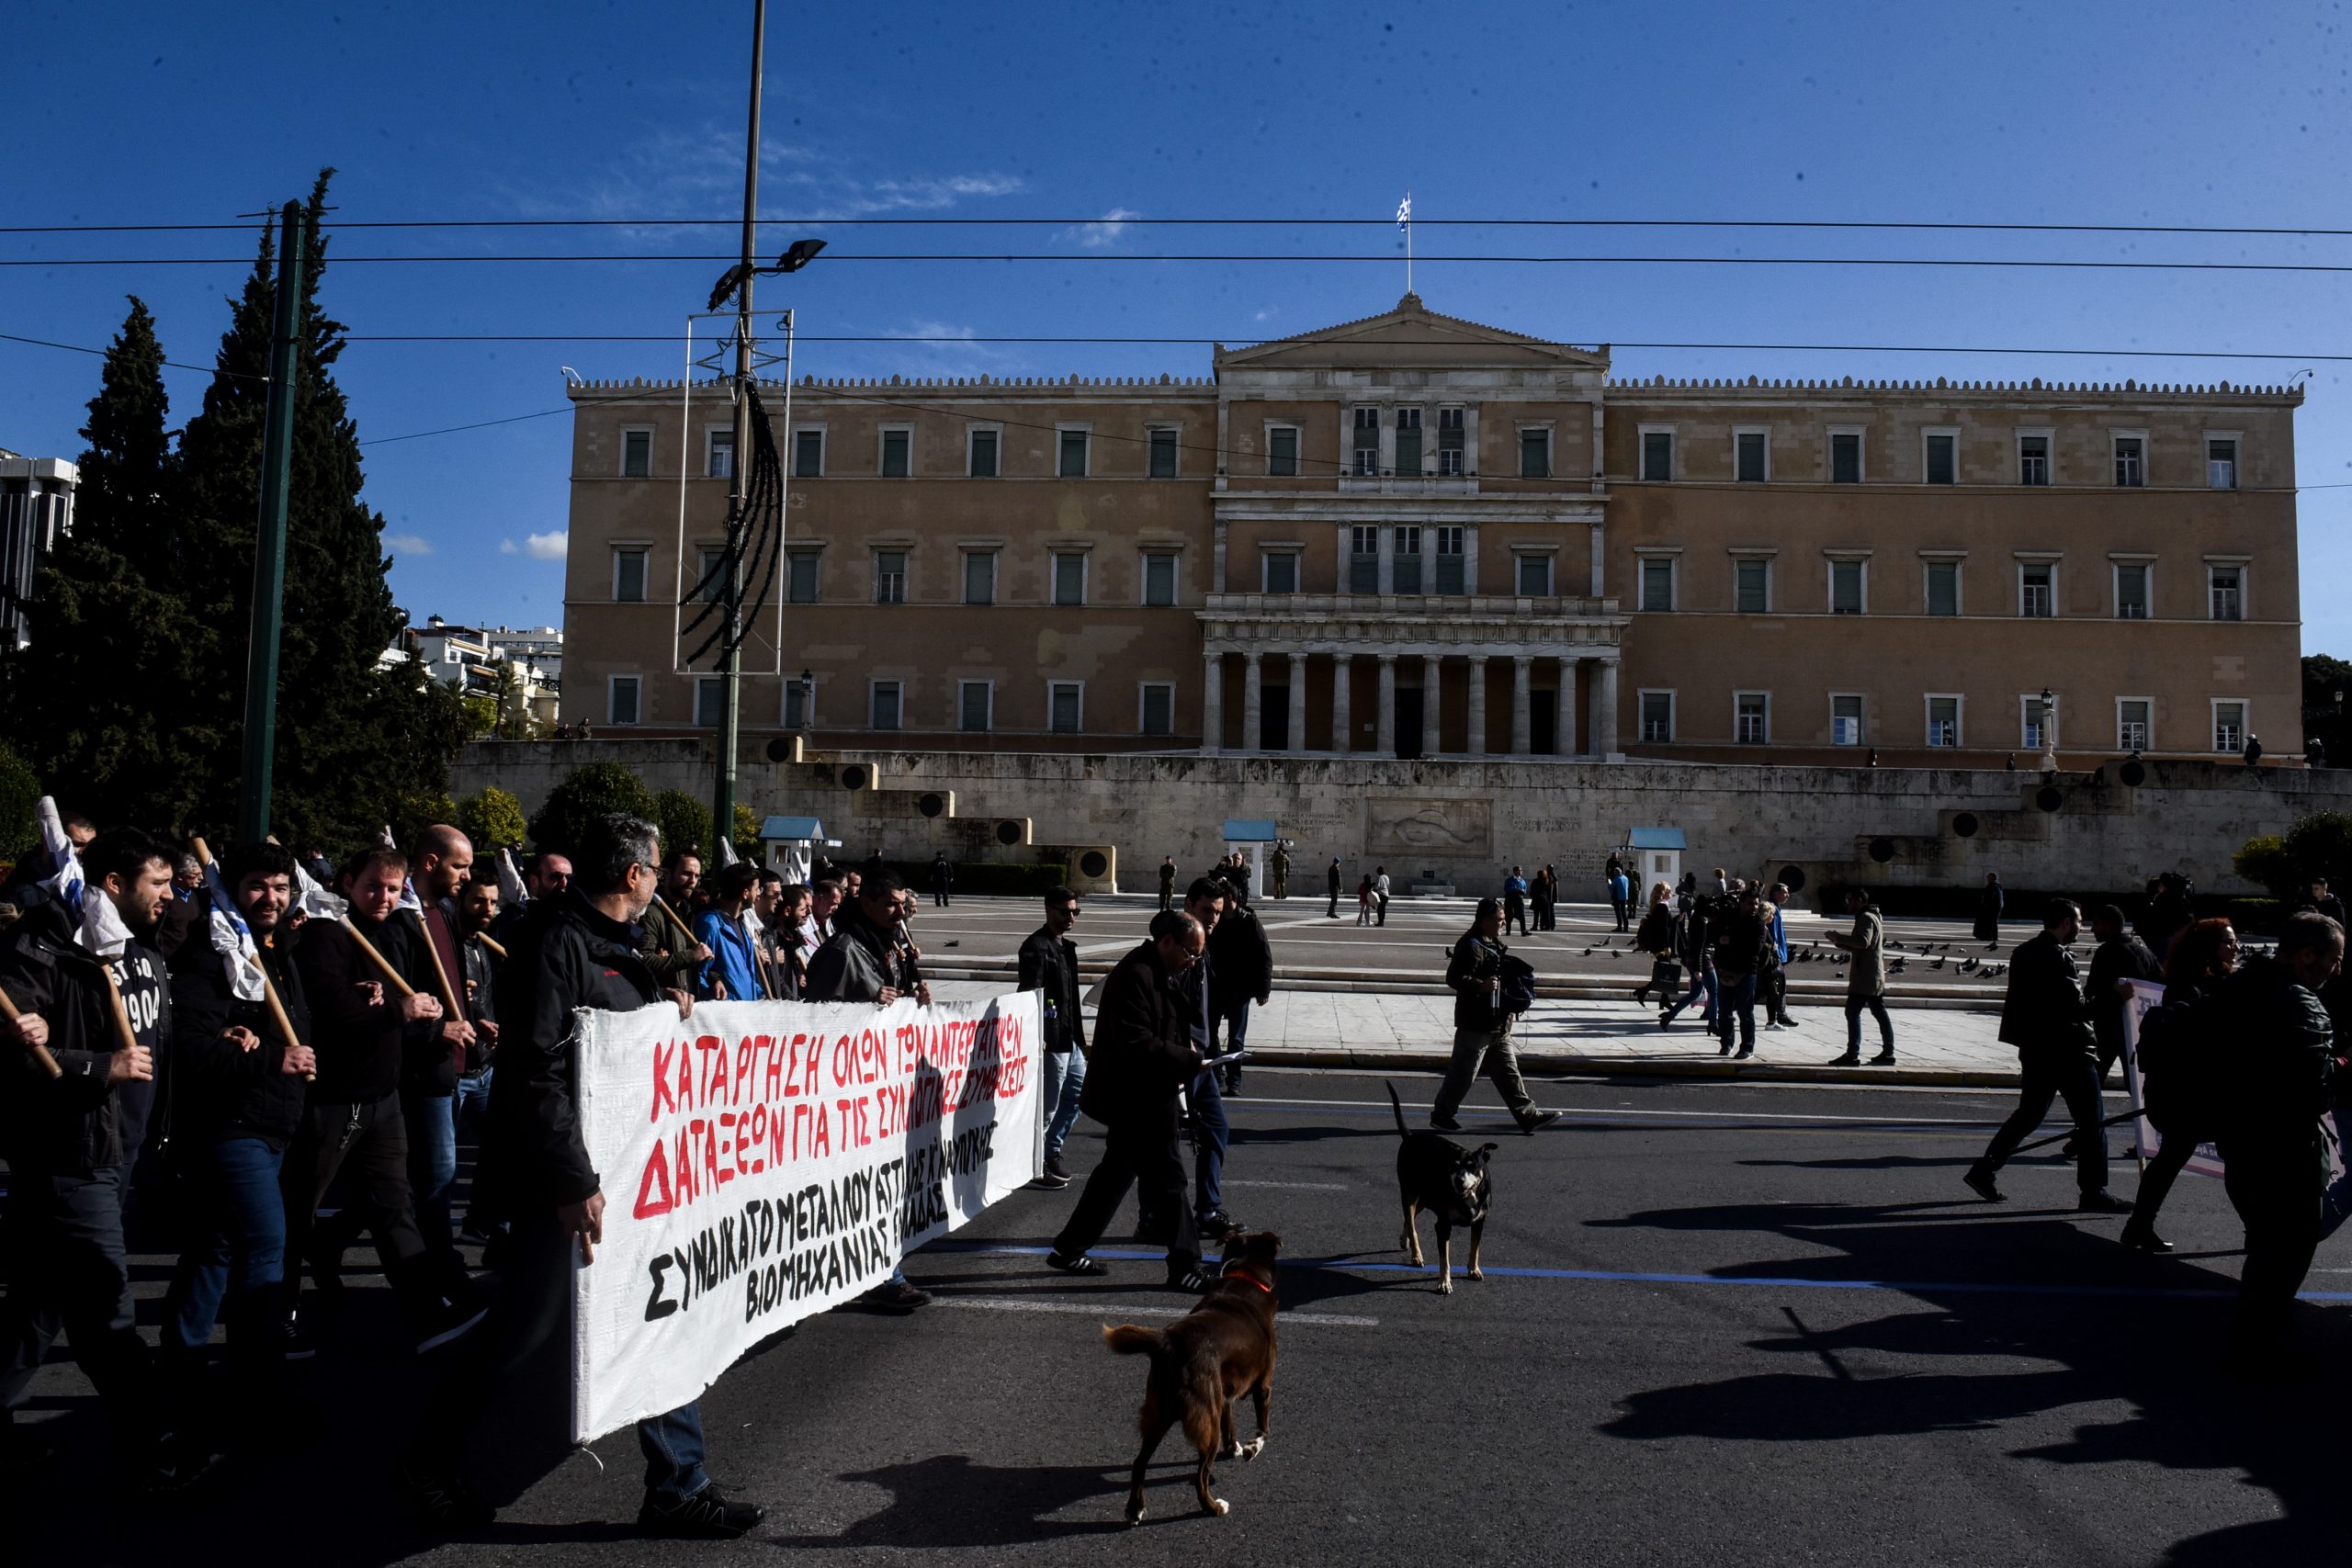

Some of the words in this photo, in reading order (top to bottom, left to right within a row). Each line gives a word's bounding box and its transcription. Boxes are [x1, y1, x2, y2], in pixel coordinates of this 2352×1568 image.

[633, 1102, 786, 1220] ΔΙΑΤΑΞΕΩΝ
[794, 1100, 830, 1161] ΓΙΑ
[837, 1096, 870, 1152] ΤΙΣ
[876, 1069, 962, 1138] ΣΥΛΛΟΓΙΚΕΣ
[958, 1055, 1027, 1110] ΣΥΜΒΑΣΕΙΣ
[650, 1034, 823, 1123] ΚΑΤΑΡΓΗΣΗ
[832, 1028, 888, 1088] ΟΛΩΝ
[897, 1023, 927, 1076] ΤΩΝ
[930, 1013, 1023, 1066] ΑΝΤΕΡΓΑΤΙΚΩΝ
[644, 1199, 774, 1322] ΣΥΝΔΙΚΑΤΟ
[776, 1166, 872, 1254] ΜΕΤΑΛΛΟΥ
[876, 1149, 925, 1214] ΑΤΤΙΚΗΣ
[746, 1218, 890, 1324] ΒΙΟΜΗΧΑΝΙΑΣ
[893, 1179, 948, 1248] ΕΛΛΑΔΑΣ
